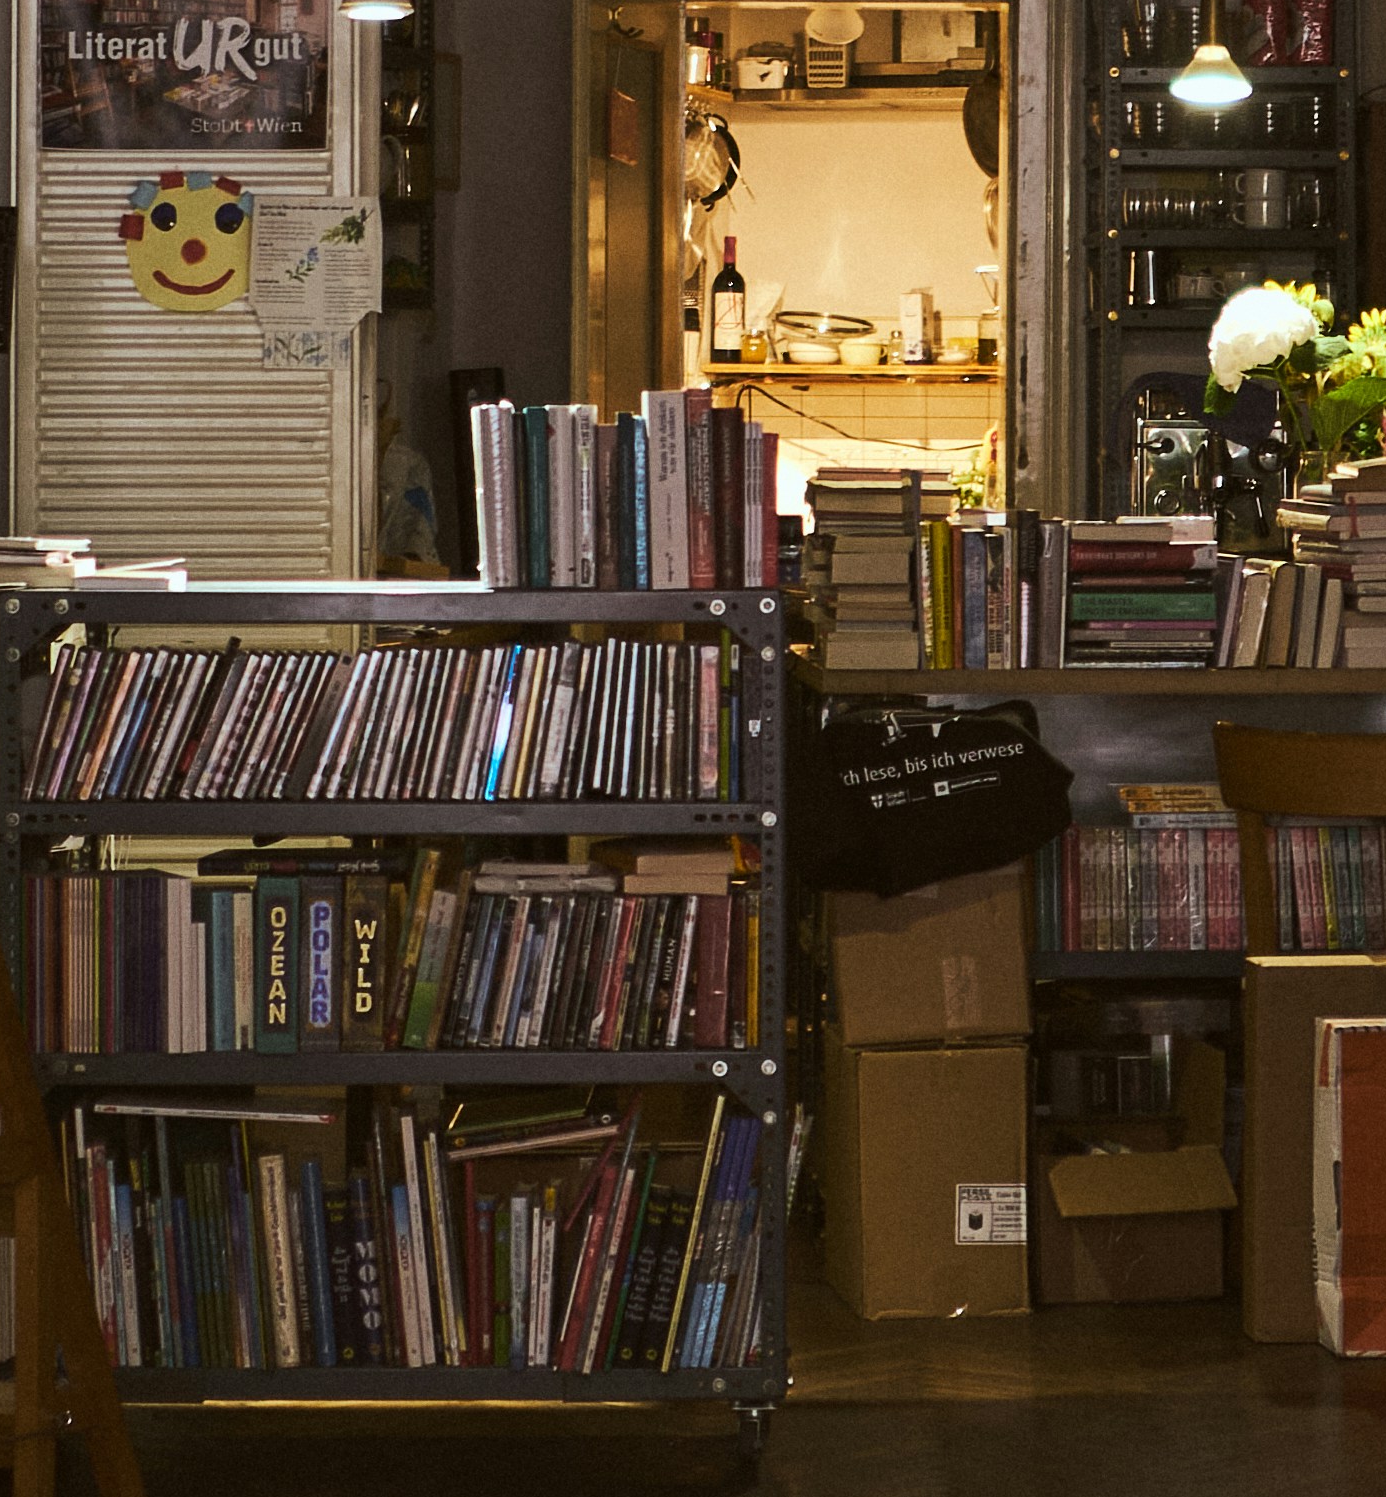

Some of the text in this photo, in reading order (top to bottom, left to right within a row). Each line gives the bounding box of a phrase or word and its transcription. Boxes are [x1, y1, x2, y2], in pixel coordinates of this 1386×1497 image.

[256, 116, 304, 134] Wien
[863, 766, 902, 784] lese,
[904, 755, 928, 775] bis
[931, 751, 955, 770] ich
[958, 741, 1025, 765] verwese
[268, 906, 288, 1025] OZEAN
[310, 906, 330, 1024] POLAR
[354, 919, 377, 1014] WILD
[661, 937, 677, 984] HUMAN
[354, 1240, 382, 1330] MOMO
